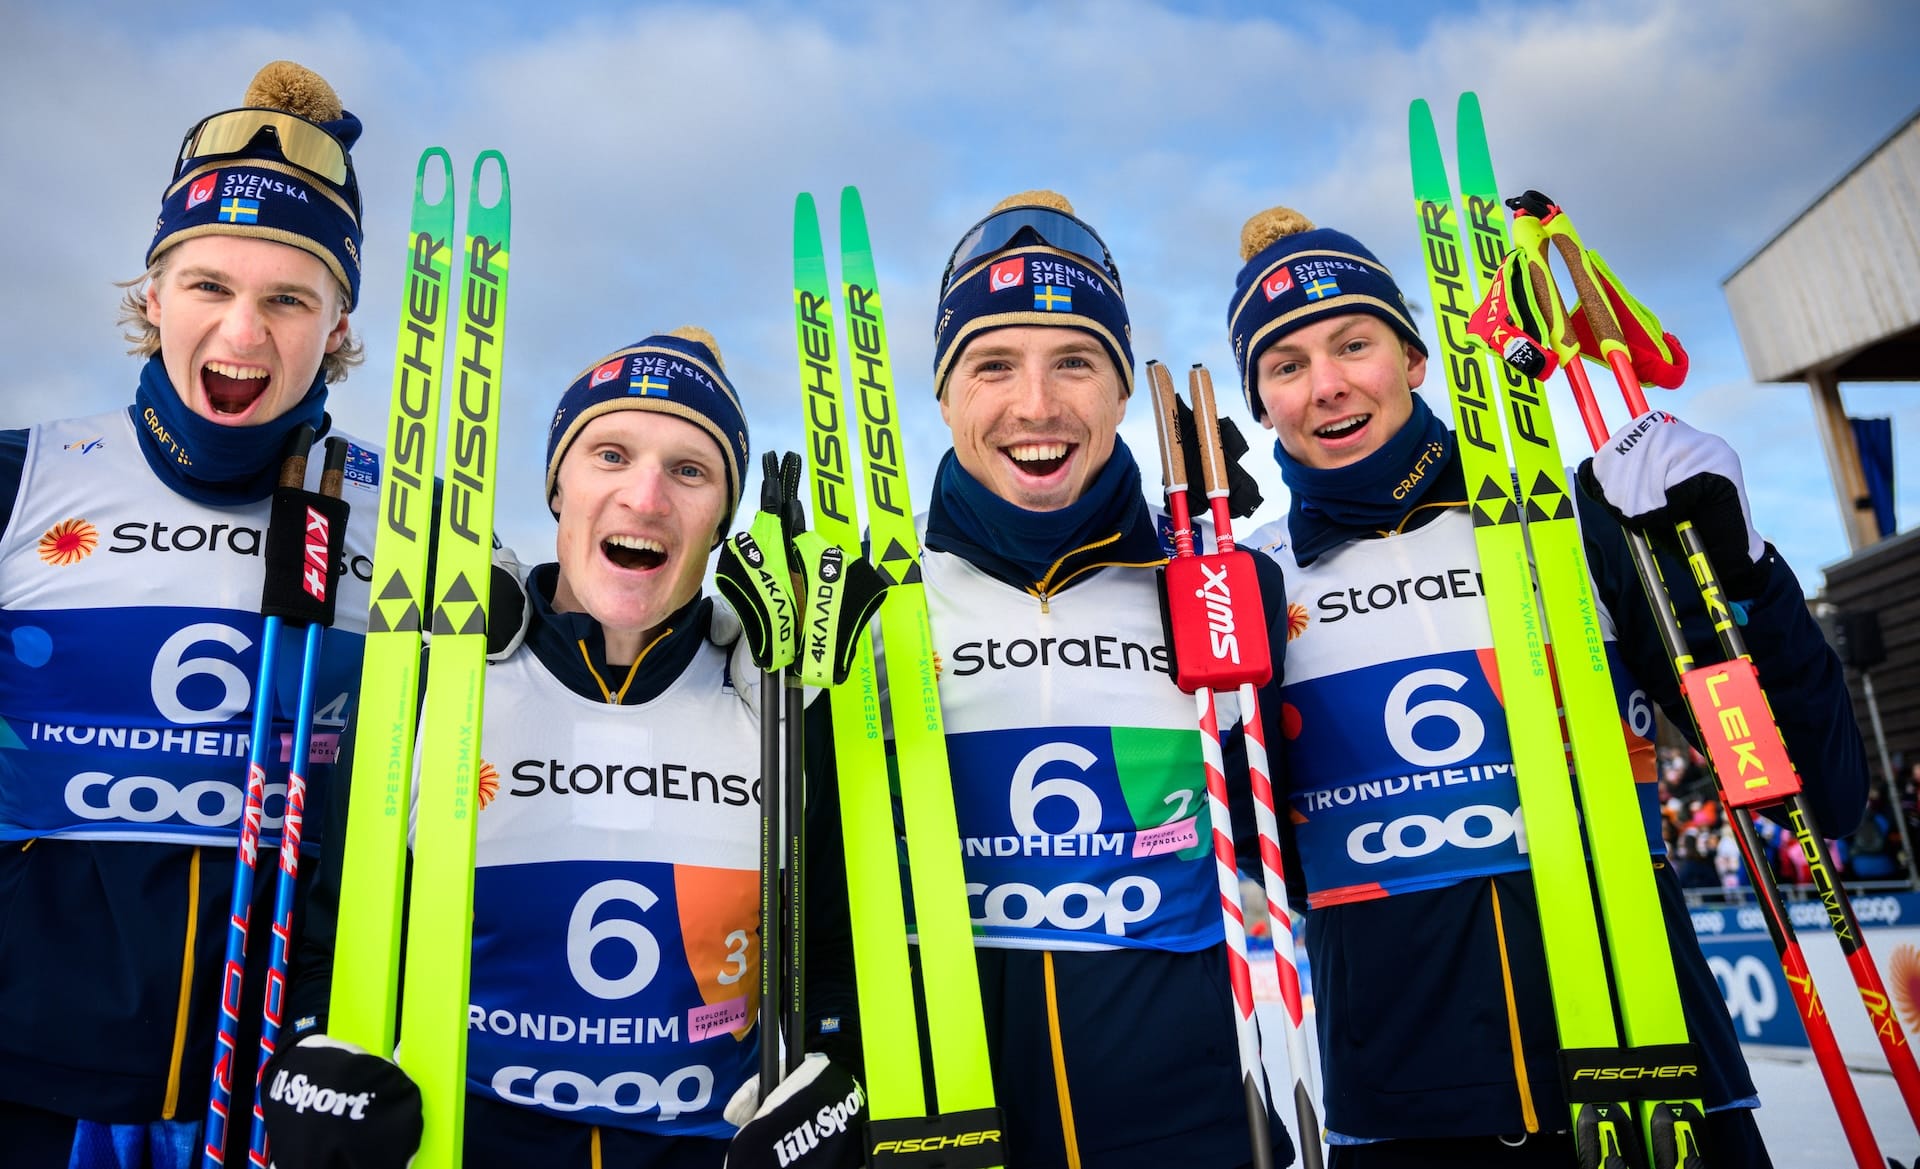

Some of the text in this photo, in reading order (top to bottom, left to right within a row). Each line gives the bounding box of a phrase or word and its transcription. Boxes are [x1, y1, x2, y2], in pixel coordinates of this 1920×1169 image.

[222, 186, 266, 200] SPEL
[225, 174, 309, 203] SVENSKA
[1031, 261, 1106, 295] SVENSKA
[1033, 272, 1076, 288] SPEL
[1294, 261, 1369, 275] SVENSKA
[1298, 268, 1338, 284] SPEL
[1422, 200, 1497, 453] FISCHER
[1468, 194, 1550, 448] FISER
[388, 232, 445, 543] FISCHER
[450, 235, 502, 546] FISCHER
[631, 367, 675, 379] SPEL
[632, 357, 715, 392] SVENSKA
[850, 283, 904, 517] FISCHER
[144, 407, 179, 454] CRAFT
[799, 290, 849, 525] FISCHER
[1392, 450, 1434, 501] CRAFT
[108, 521, 373, 582] Storaso
[307, 505, 330, 602] KV+
[758, 569, 790, 642] 4KAAD
[811, 585, 833, 663] 4KAAD
[1316, 568, 1485, 624] StoraE
[1521, 602, 1544, 676] SPEEDMAX
[1578, 598, 1604, 672] SPEEDMAX
[151, 622, 252, 725] 6
[860, 667, 878, 739] SPEEDMAX
[919, 659, 938, 731] SPEEDMAX
[313, 692, 347, 727] 4
[1385, 668, 1485, 768] 6
[1628, 689, 1652, 737] 6
[1705, 673, 1769, 790] LEKI
[385, 723, 403, 817] SPEEDMAX
[455, 725, 472, 820] SPEEDMAX
[1010, 742, 1103, 837] 6
[961, 833, 1124, 857] NDHEIM
[965, 875, 1161, 937] coop
[1850, 896, 1902, 925] coop
[567, 879, 661, 1000] 6
[717, 930, 749, 985] 3
[695, 1009, 728, 1023] EXPLORE
[491, 1064, 714, 1122] coop
[1573, 1065, 1698, 1081] FISCHER
[873, 1130, 1001, 1155] FISCHER
